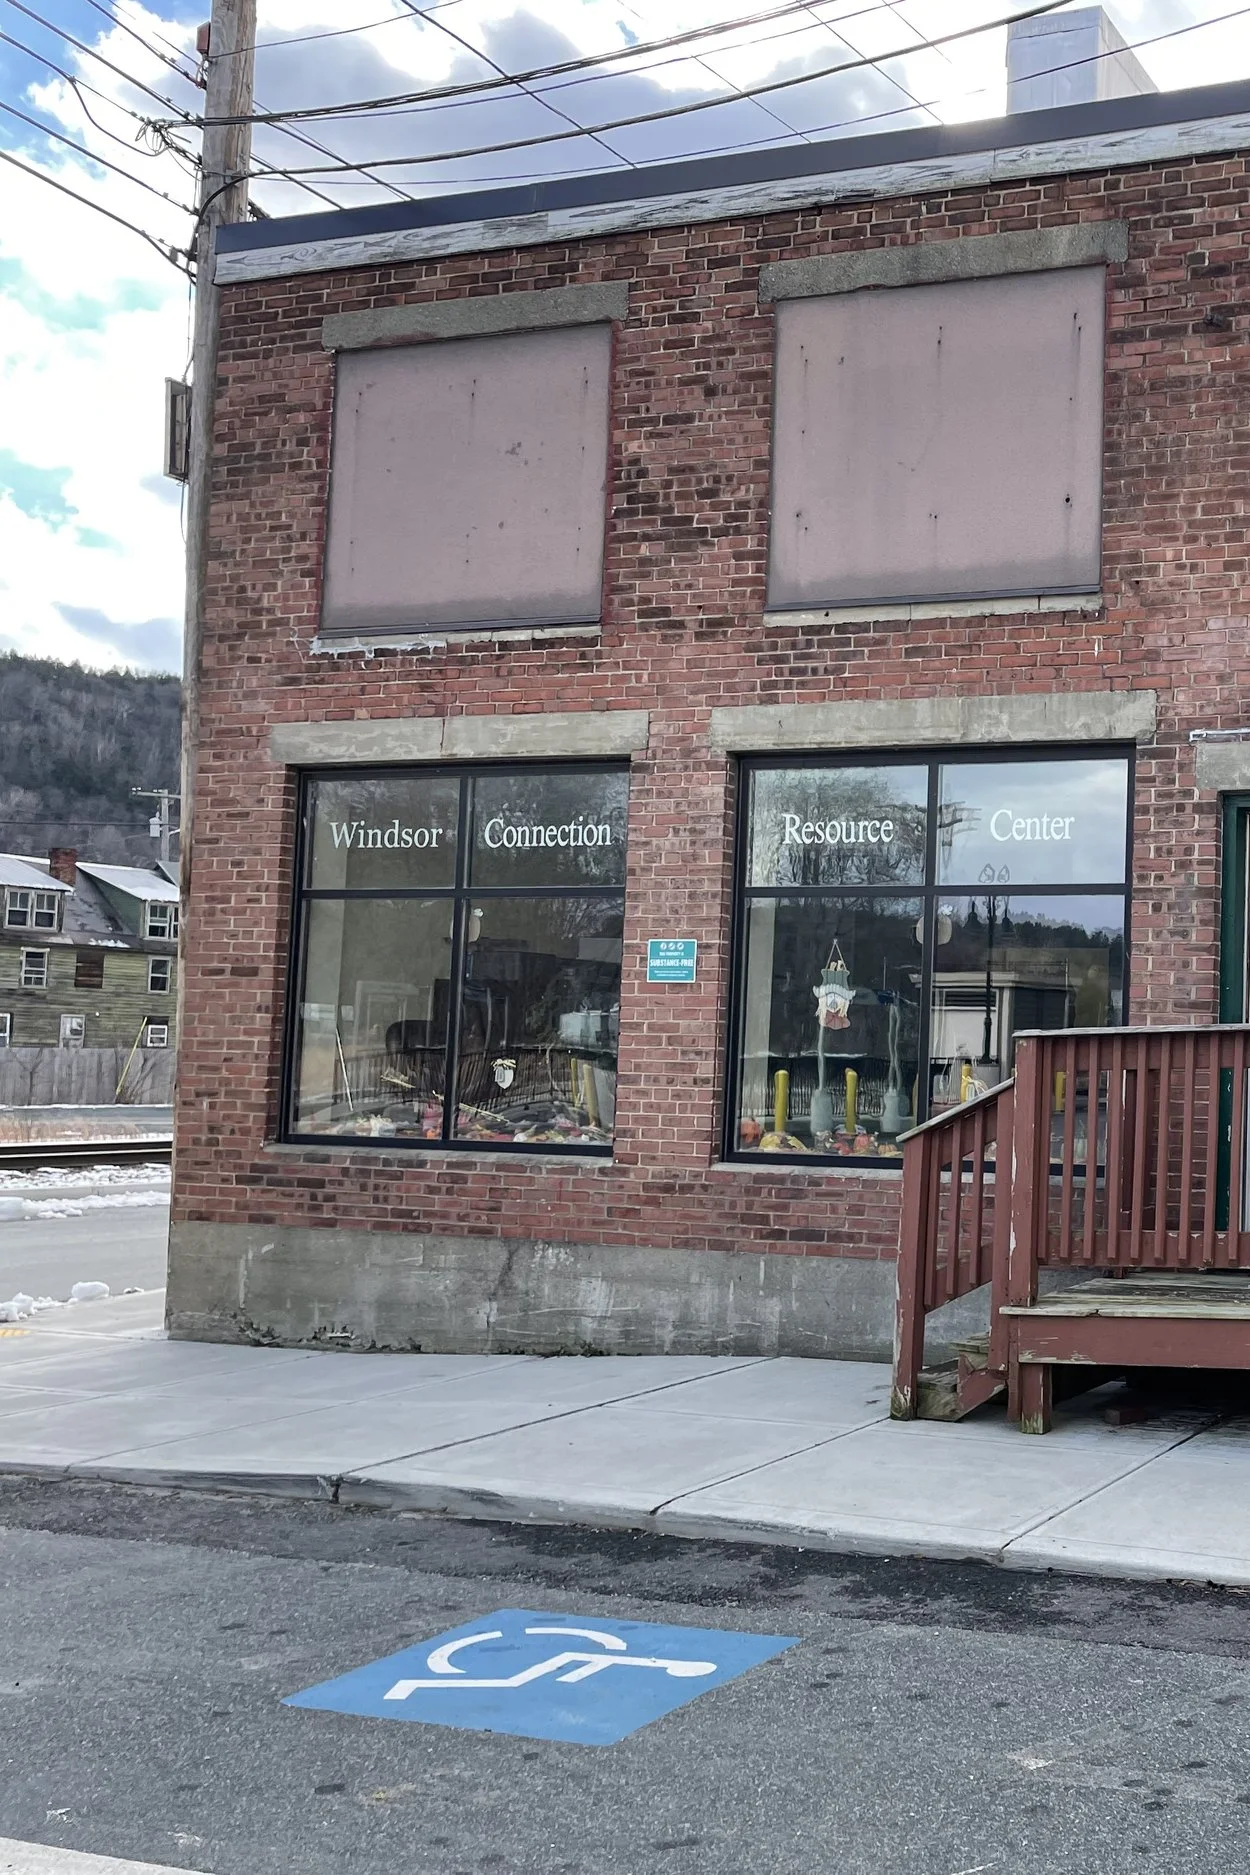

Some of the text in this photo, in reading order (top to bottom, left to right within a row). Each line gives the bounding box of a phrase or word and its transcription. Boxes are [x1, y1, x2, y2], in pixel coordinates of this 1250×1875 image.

[331, 809, 1076, 849] Windsor Connection Resource Center
[650, 958, 694, 967] SUBSTANCE-FREE
